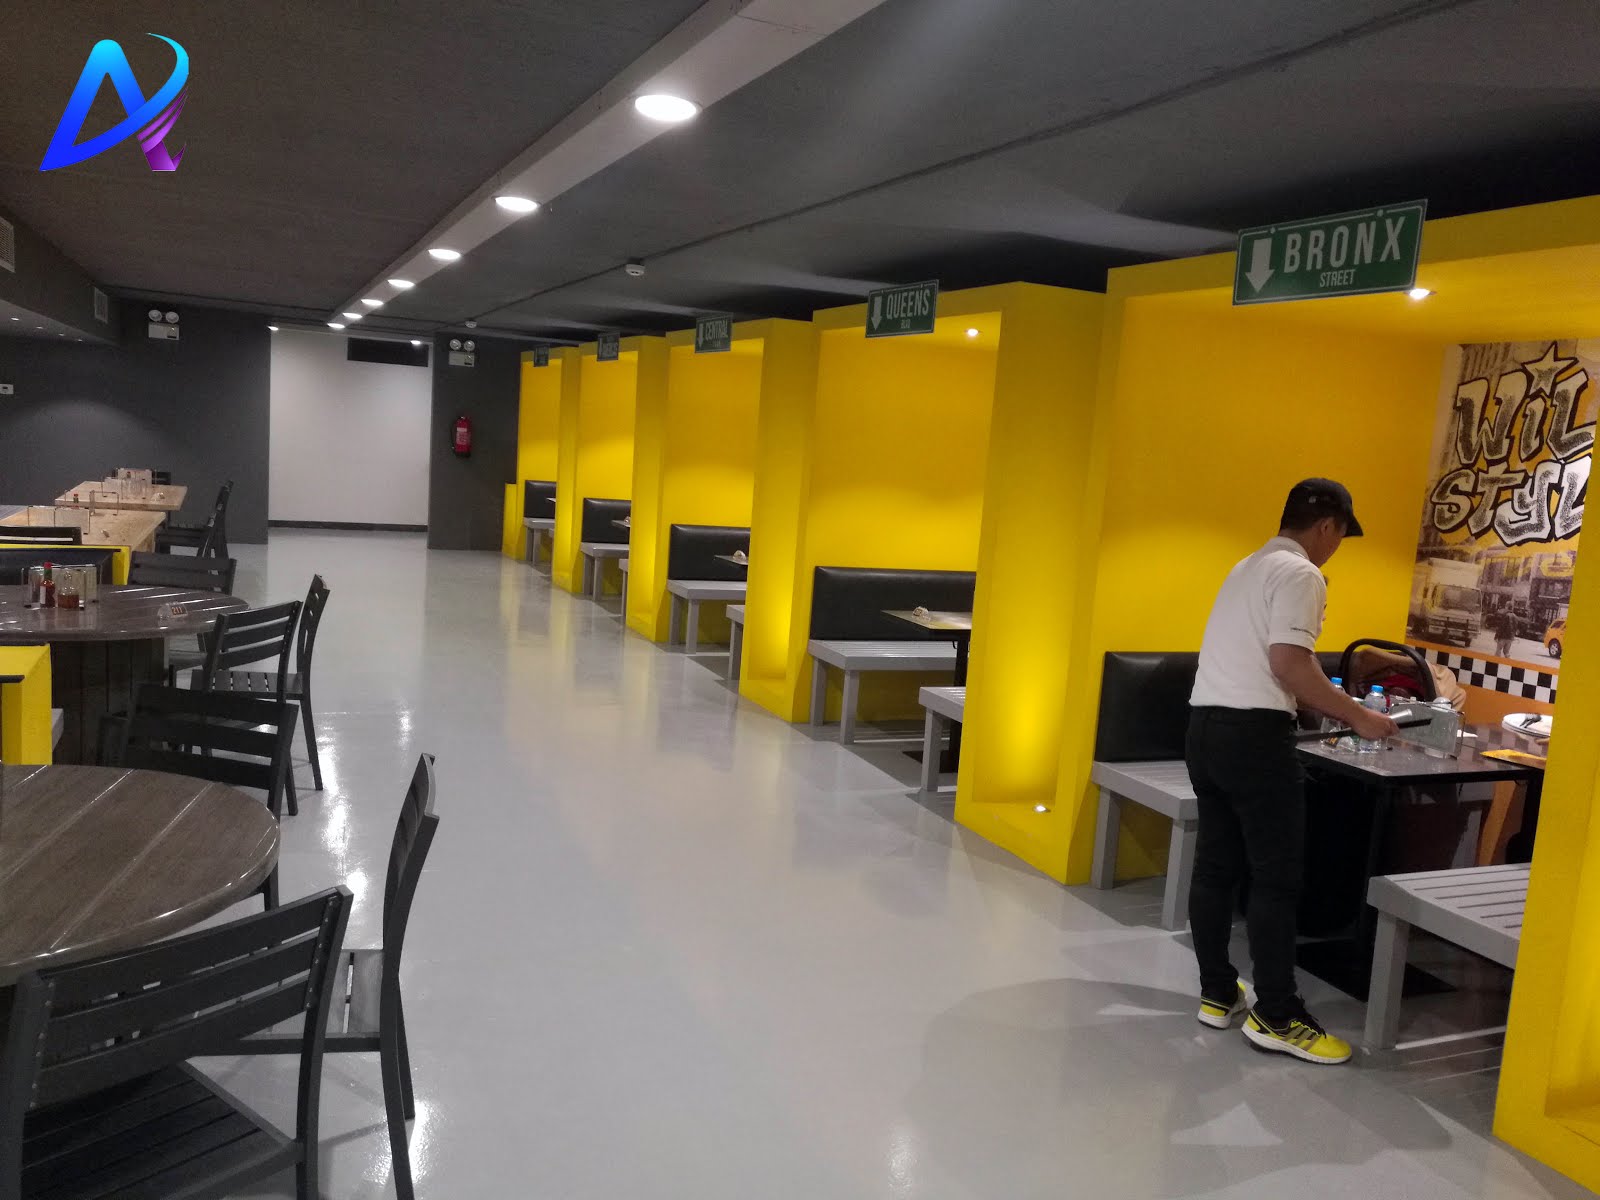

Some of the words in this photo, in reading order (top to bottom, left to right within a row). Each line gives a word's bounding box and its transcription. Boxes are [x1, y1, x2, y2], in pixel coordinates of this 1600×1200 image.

[1283, 216, 1406, 274] BRONX
[1319, 268, 1357, 288] STREET
[886, 288, 931, 320] QUEENS
